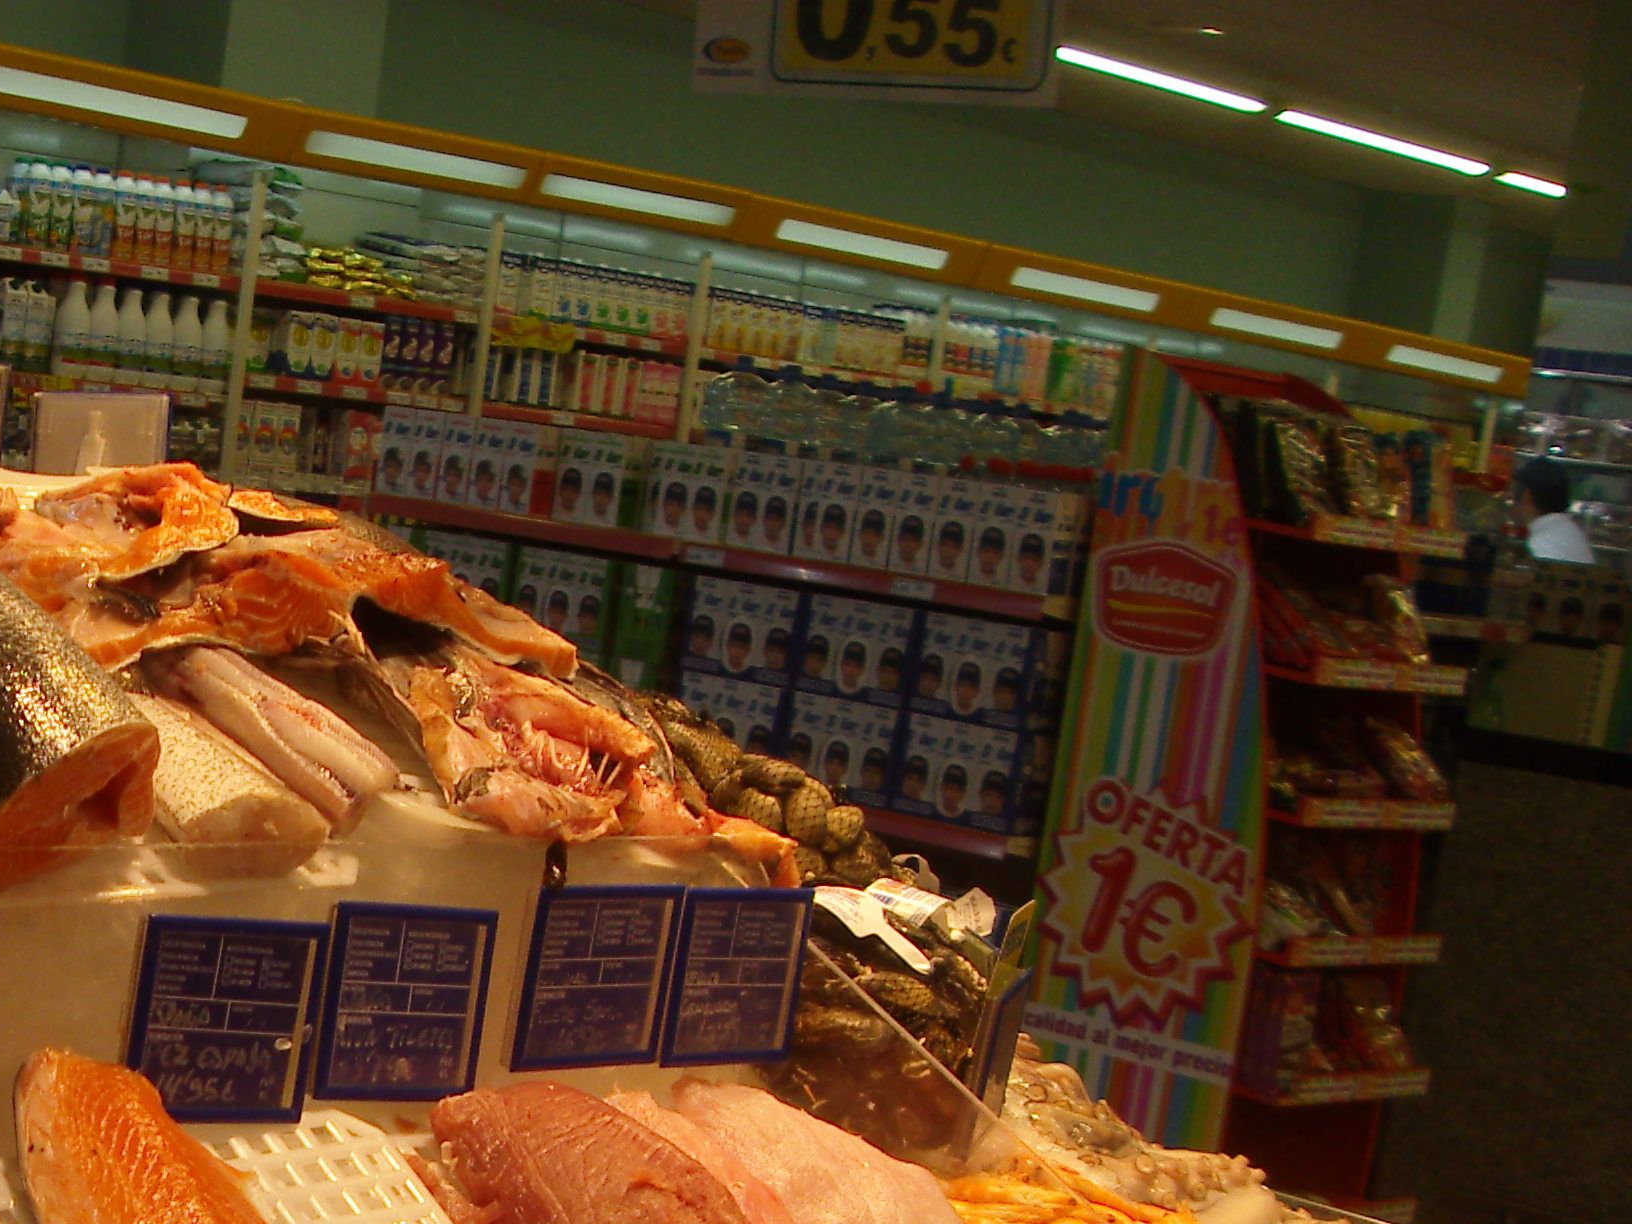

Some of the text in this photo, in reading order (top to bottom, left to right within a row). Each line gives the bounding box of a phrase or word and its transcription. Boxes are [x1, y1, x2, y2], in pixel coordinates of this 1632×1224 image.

[1109, 563, 1223, 609] Dulcesol
[1087, 779, 1247, 896] OFERTA
[1080, 846, 1198, 977] 1€
[1023, 1009, 1087, 1040] calidad
[1093, 1027, 1110, 1044] al
